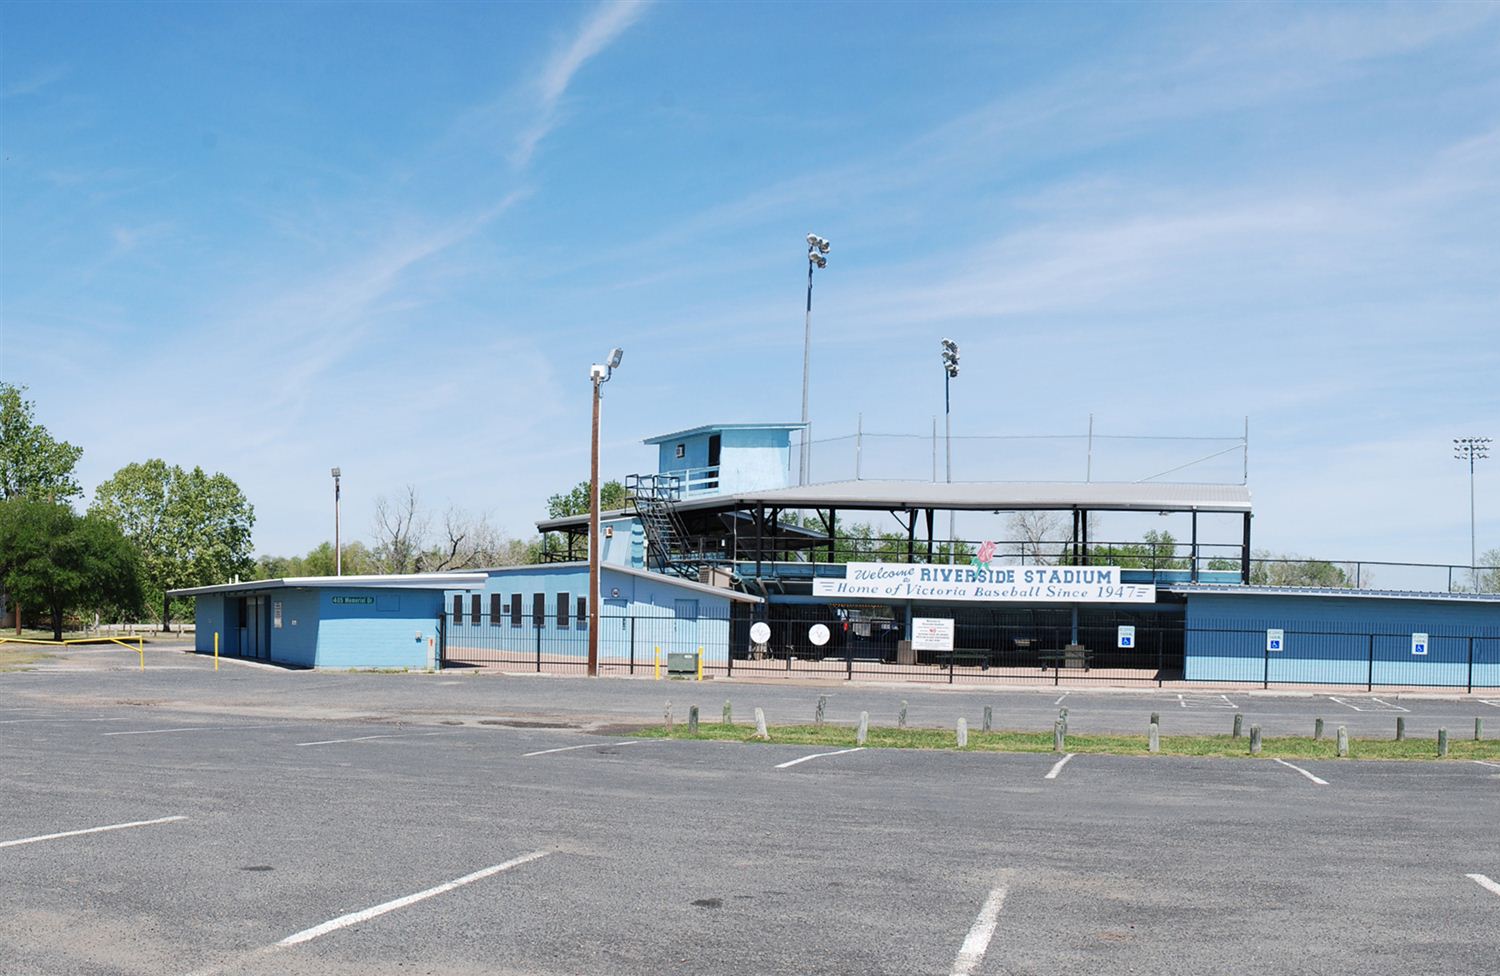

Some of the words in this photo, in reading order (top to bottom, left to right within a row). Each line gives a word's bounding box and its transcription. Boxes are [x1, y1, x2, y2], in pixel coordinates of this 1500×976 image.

[854, 567, 915, 580] Welcome
[920, 568, 1015, 584] RIVERSIDE
[1024, 570, 1112, 584] STADIUM
[837, 582, 879, 594] Home
[885, 583, 903, 596] of
[906, 583, 966, 596] Victoria
[974, 586, 1040, 597] Baseball
[1046, 585, 1088, 598] Since
[1097, 586, 1135, 598] 1947
